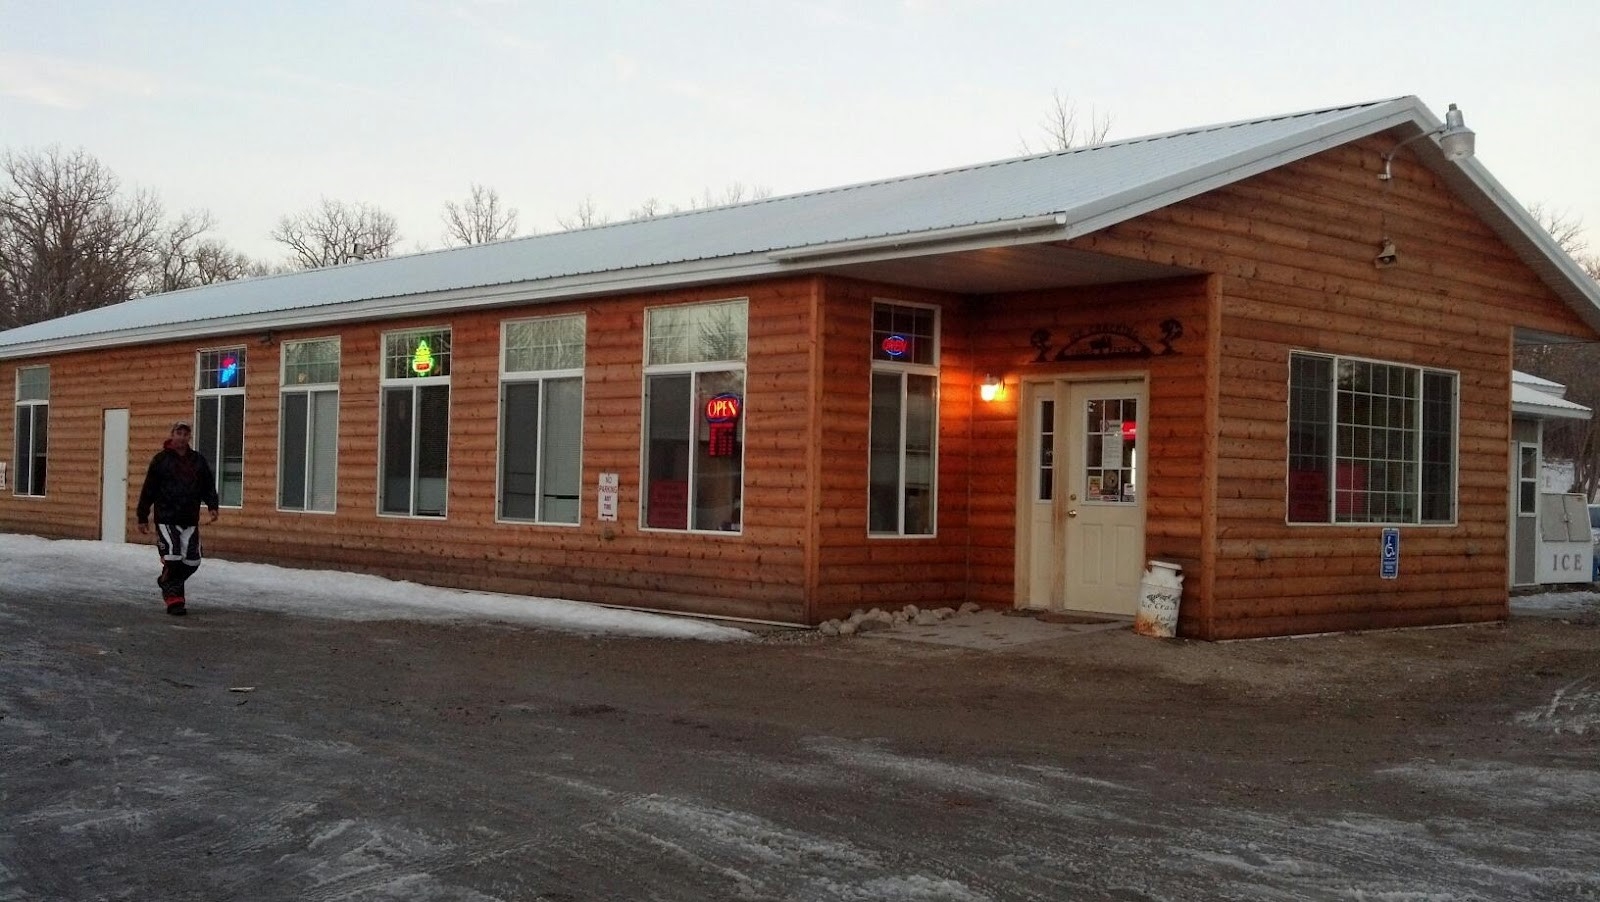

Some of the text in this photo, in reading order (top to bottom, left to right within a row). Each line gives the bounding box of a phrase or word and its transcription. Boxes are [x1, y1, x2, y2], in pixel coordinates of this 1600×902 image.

[707, 399, 739, 417] OPEN
[605, 476, 613, 484] NO
[599, 485, 618, 493] PARKING
[1552, 553, 1583, 571] ICE
